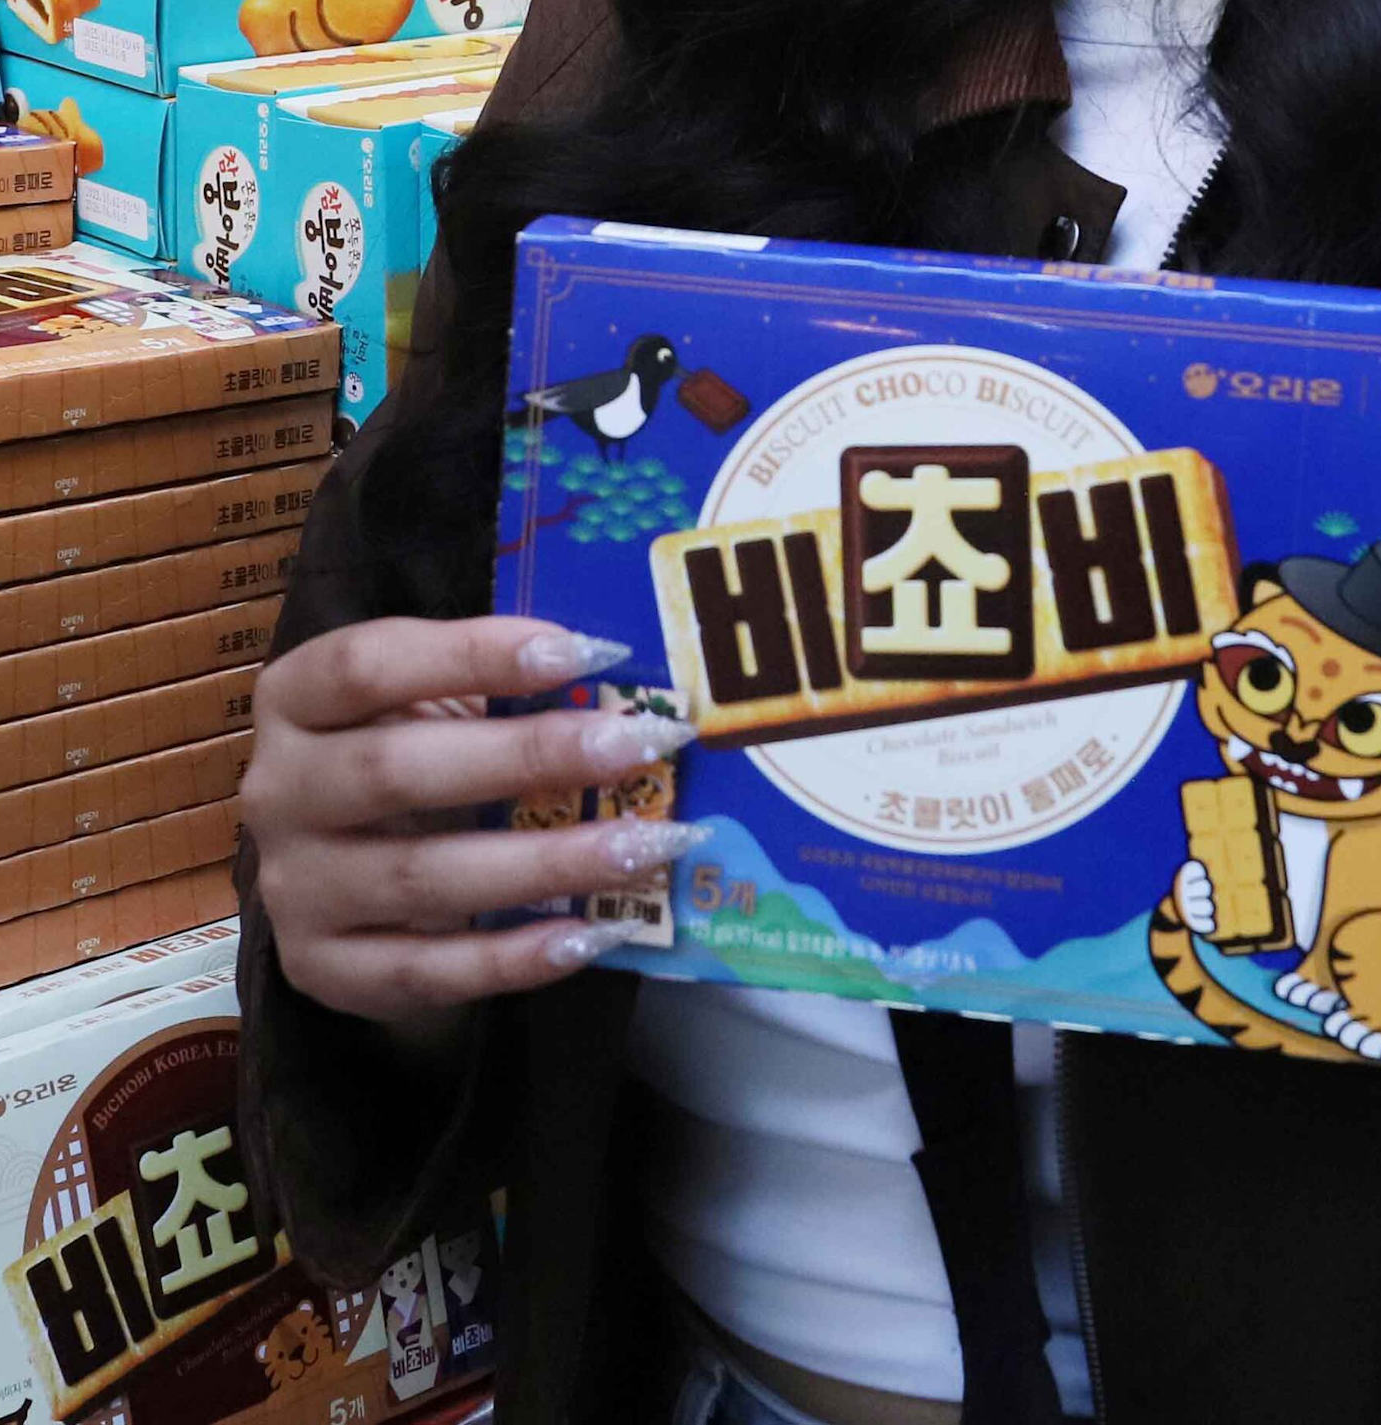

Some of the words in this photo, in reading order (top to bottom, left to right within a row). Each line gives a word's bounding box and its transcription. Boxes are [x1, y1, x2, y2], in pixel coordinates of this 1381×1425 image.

[1230, 375, 1343, 406] 오리온
[63, 409, 86, 420] OPEN
[747, 393, 847, 488] BISCUIT
[855, 370, 966, 409] CHOCO
[977, 378, 1095, 450] BISCUIT
[685, 464, 1201, 704] 비쵸비
[60, 616, 84, 627] OPEN
[878, 790, 1014, 831] 초콜릿이
[1022, 737, 1115, 813] 통째로
[690, 865, 755, 917] 5개
[154, 1042, 212, 1074] KOREA
[14, 1073, 79, 1110] 오리온
[25, 1125, 258, 1385] 비쵸
